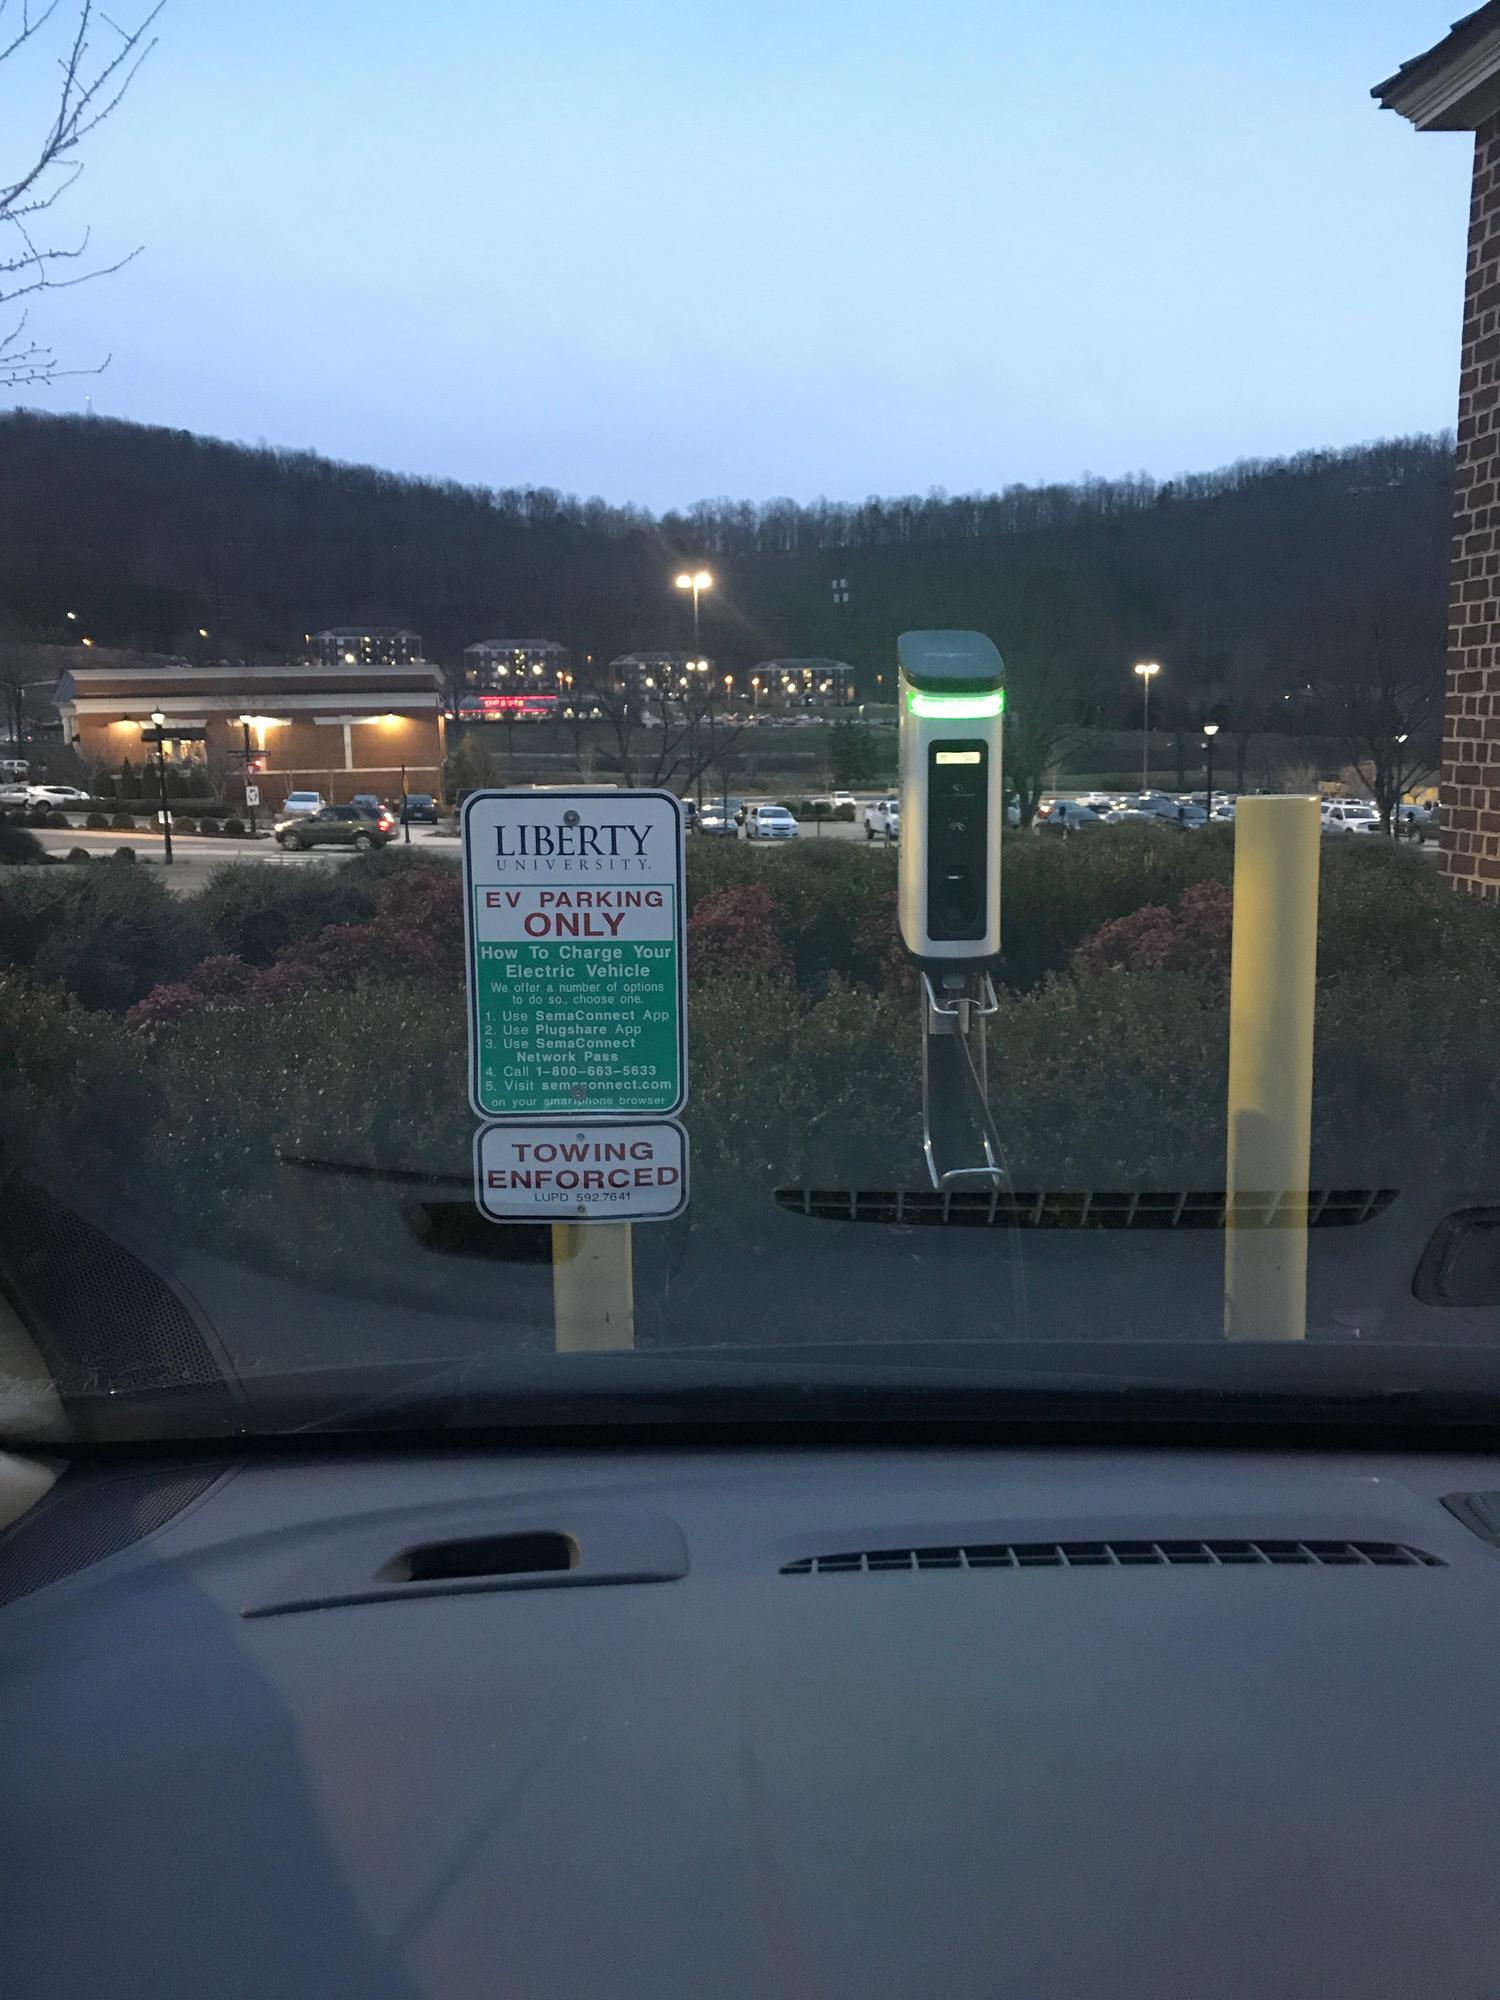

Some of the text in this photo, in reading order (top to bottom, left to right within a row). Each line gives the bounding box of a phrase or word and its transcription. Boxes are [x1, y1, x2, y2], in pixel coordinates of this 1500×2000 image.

[493, 825, 654, 857] LIBERTY
[486, 891, 664, 908] EV PARKING
[524, 912, 626, 937] ONLY
[481, 945, 672, 963] How To Charge Your
[506, 964, 650, 978] Electric Vehicle
[490, 982, 665, 995] We offer a number of options
[512, 995, 523, 1005] to
[528, 995, 543, 1005] do
[573, 995, 615, 1005] choose
[620, 996, 644, 1004] one.
[485, 1009, 670, 1022] 1. Use SemaConnect App
[484, 1024, 642, 1038] 2. Use Plugshare App
[485, 1037, 636, 1049] 3. Use SemaConnect
[516, 1051, 619, 1062] Network Pass
[485, 1064, 657, 1077] 4. Call 1-800-663-5633
[485, 1081, 497, 1091] 5.
[504, 1080, 534, 1091] Visit
[491, 1099, 506, 1107] on
[512, 1098, 538, 1108] your
[619, 1095, 665, 1105] browser
[511, 1141, 654, 1163] TOWING
[487, 1166, 680, 1190] ENFORCED
[534, 1192, 569, 1202] LUPD
